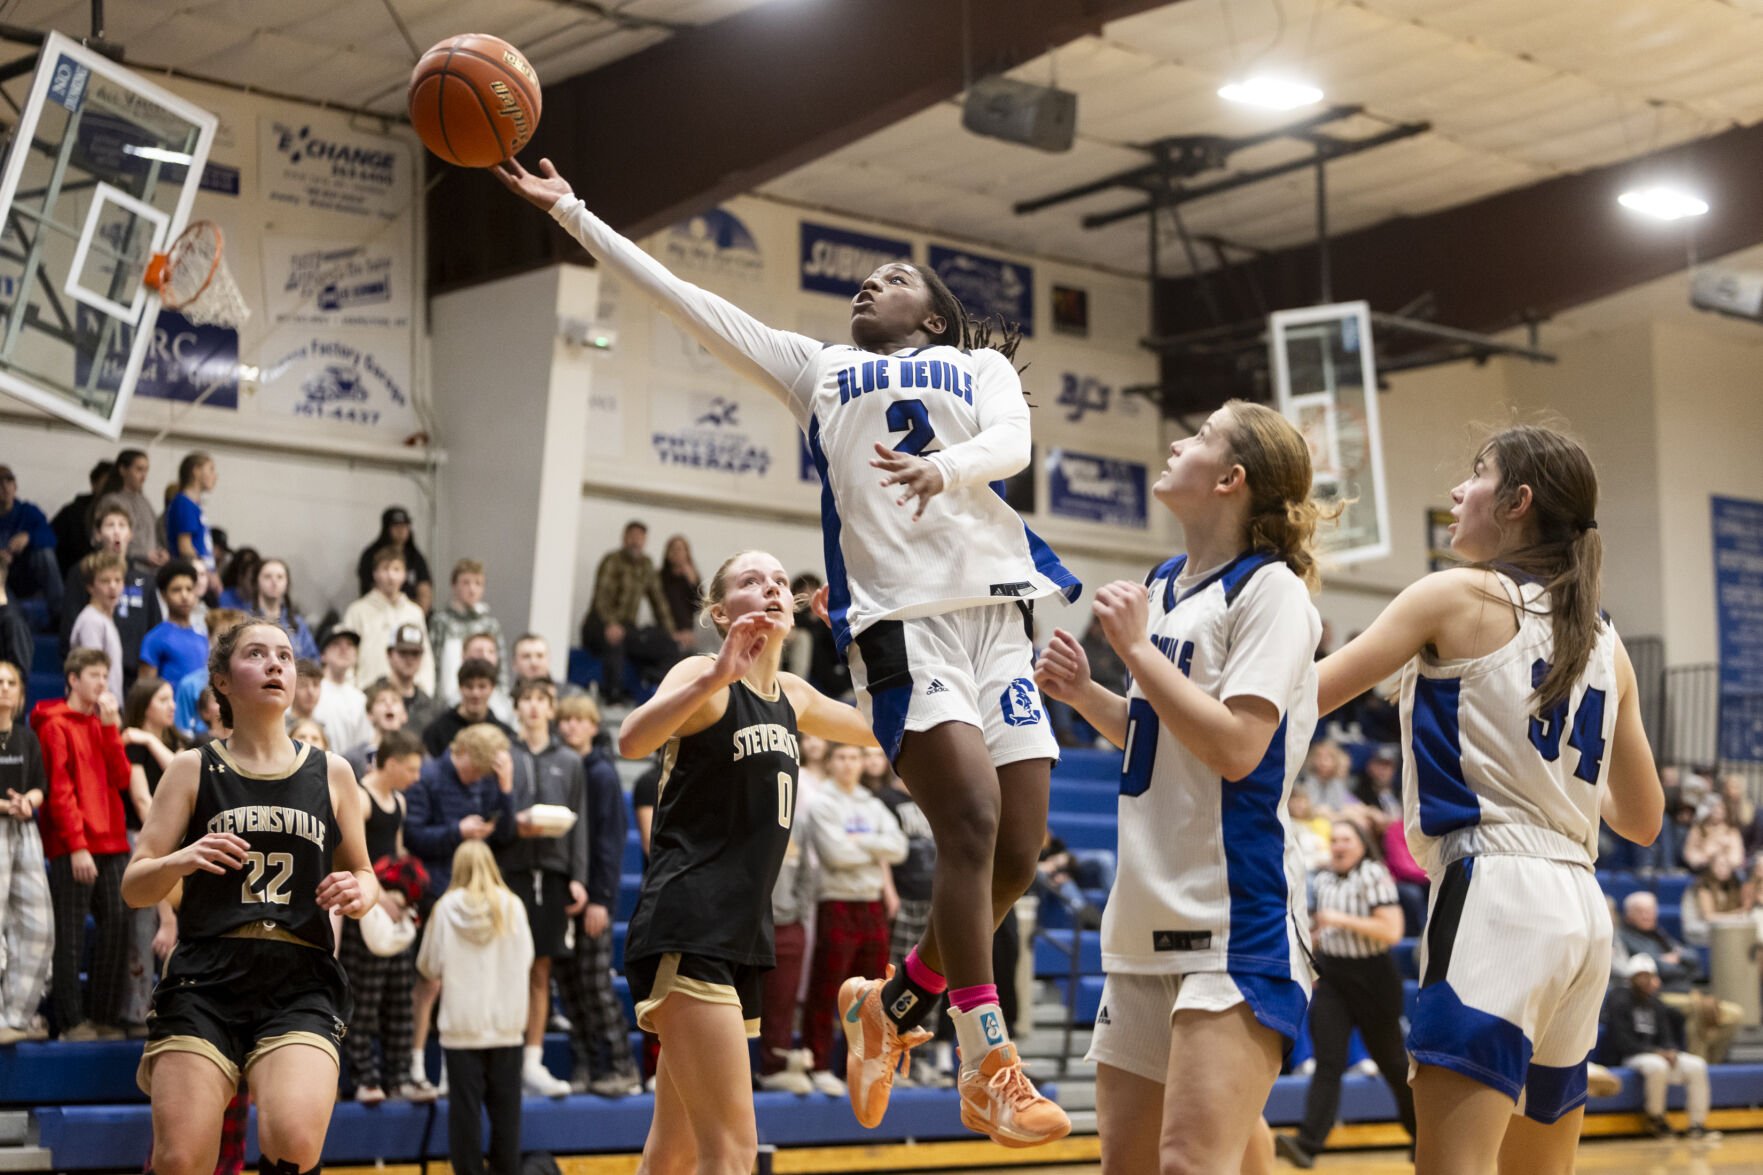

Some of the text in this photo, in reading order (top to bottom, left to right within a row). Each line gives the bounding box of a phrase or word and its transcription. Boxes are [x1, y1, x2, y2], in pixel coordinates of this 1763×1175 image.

[52, 63, 73, 96] NO
[837, 359, 973, 406] BLUE DEVILS
[657, 449, 768, 478] THERAPY
[886, 399, 940, 482] 2
[1527, 657, 1606, 786] 34
[777, 771, 793, 829] 0
[207, 805, 326, 852] STEVENSVILLE
[241, 851, 294, 905] 22
